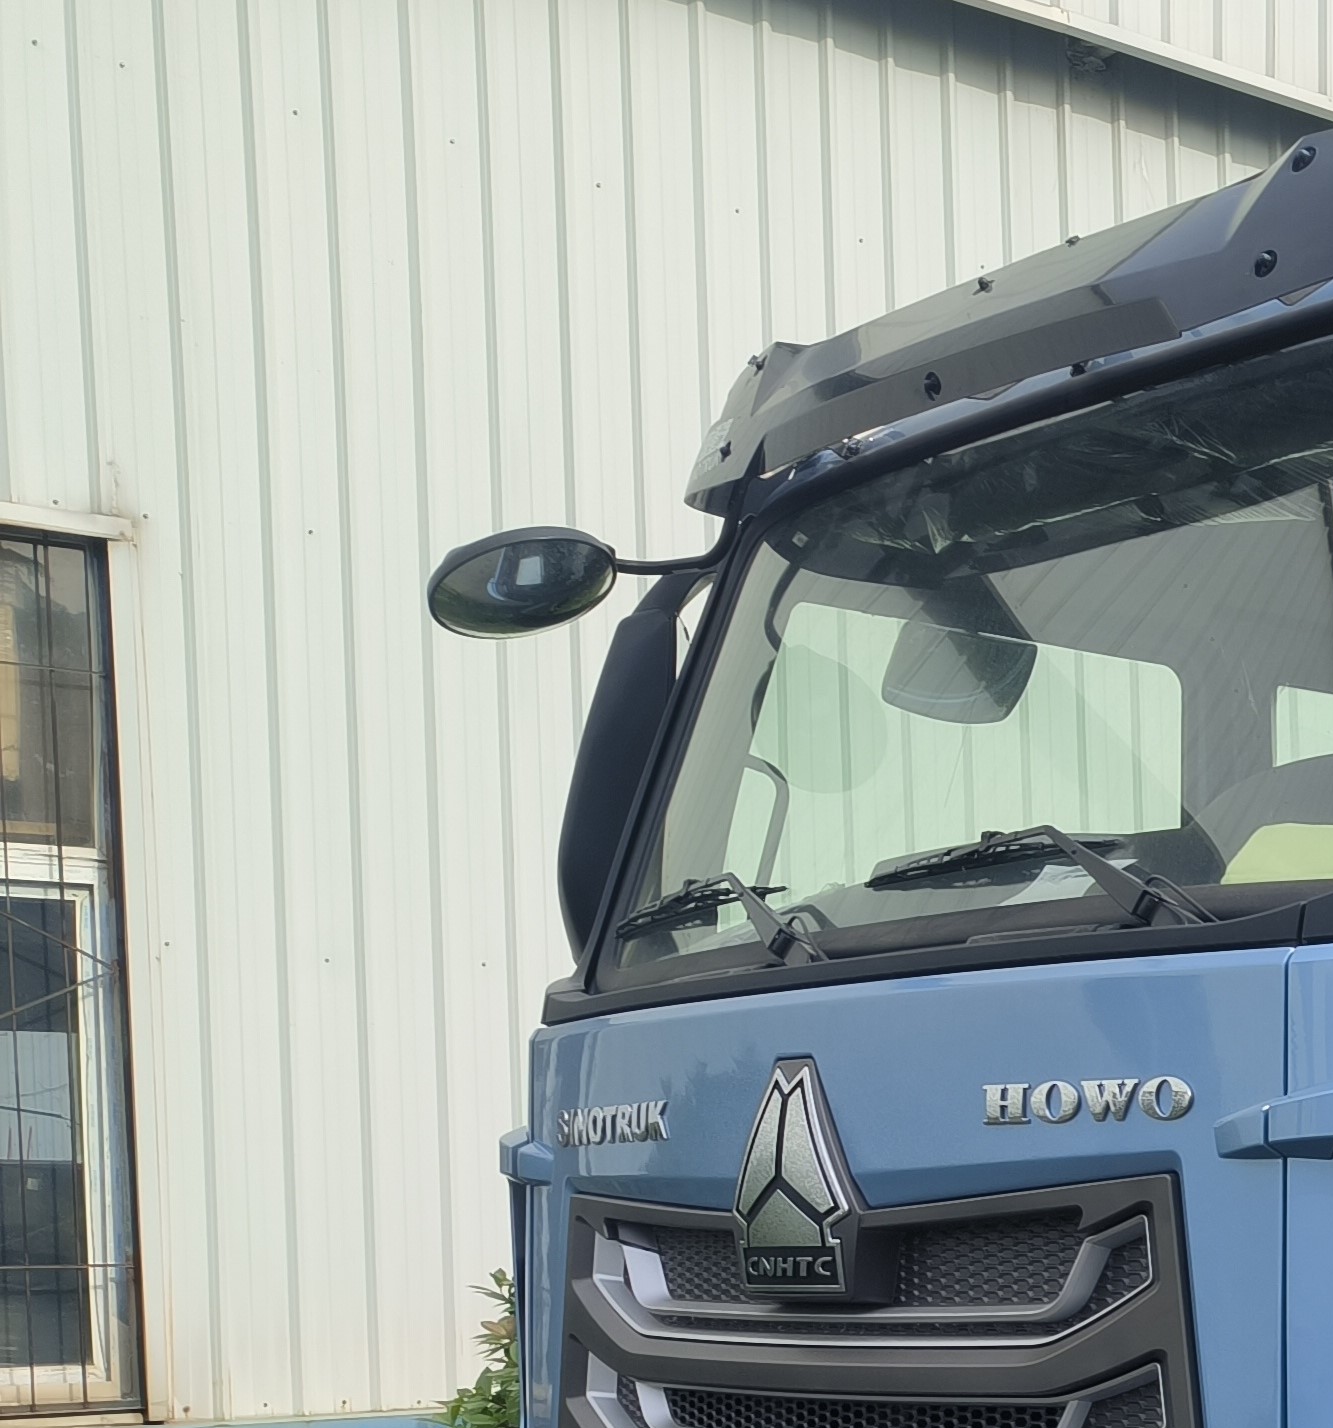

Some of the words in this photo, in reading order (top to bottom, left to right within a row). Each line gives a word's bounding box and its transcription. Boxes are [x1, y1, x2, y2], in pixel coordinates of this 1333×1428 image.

[557, 1100, 669, 1147] SINOTRUK
[982, 1076, 1194, 1125] HOWO
[747, 1256, 833, 1277] CNHTC
